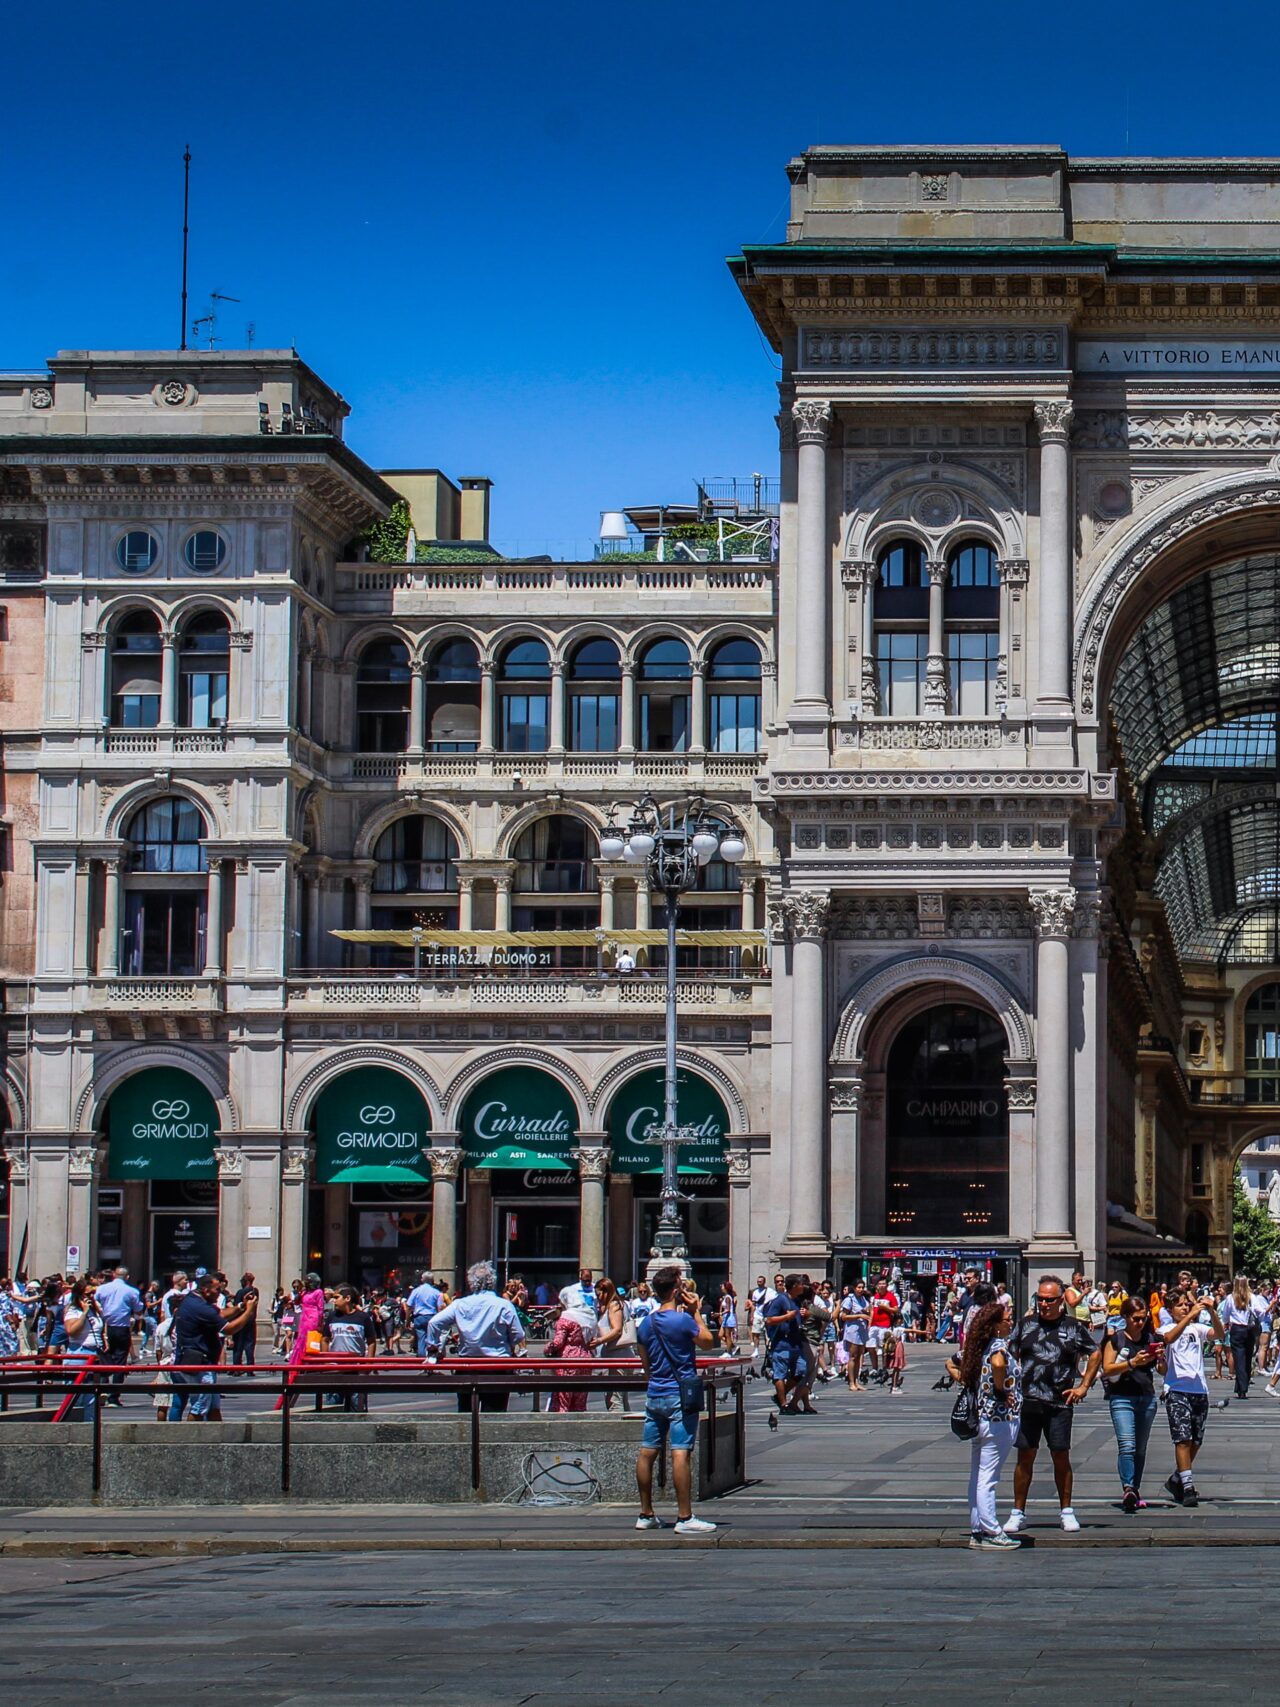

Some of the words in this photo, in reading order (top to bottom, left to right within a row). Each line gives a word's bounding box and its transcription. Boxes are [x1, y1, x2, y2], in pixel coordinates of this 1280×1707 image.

[1099, 350, 1111, 364] A
[1123, 350, 1210, 364] VITTORIO
[494, 953, 537, 965] DUOMO
[539, 953, 551, 964] 21
[905, 1099, 999, 1117] CAMPARINO
[474, 1101, 570, 1140] Currado
[132, 1123, 209, 1139] GRIMOLDI
[514, 1132, 569, 1141] GIOIELLERIE
[336, 1132, 418, 1148] GRIMOLDI
[522, 1169, 576, 1189] Currado
[677, 1173, 719, 1186] urrado
